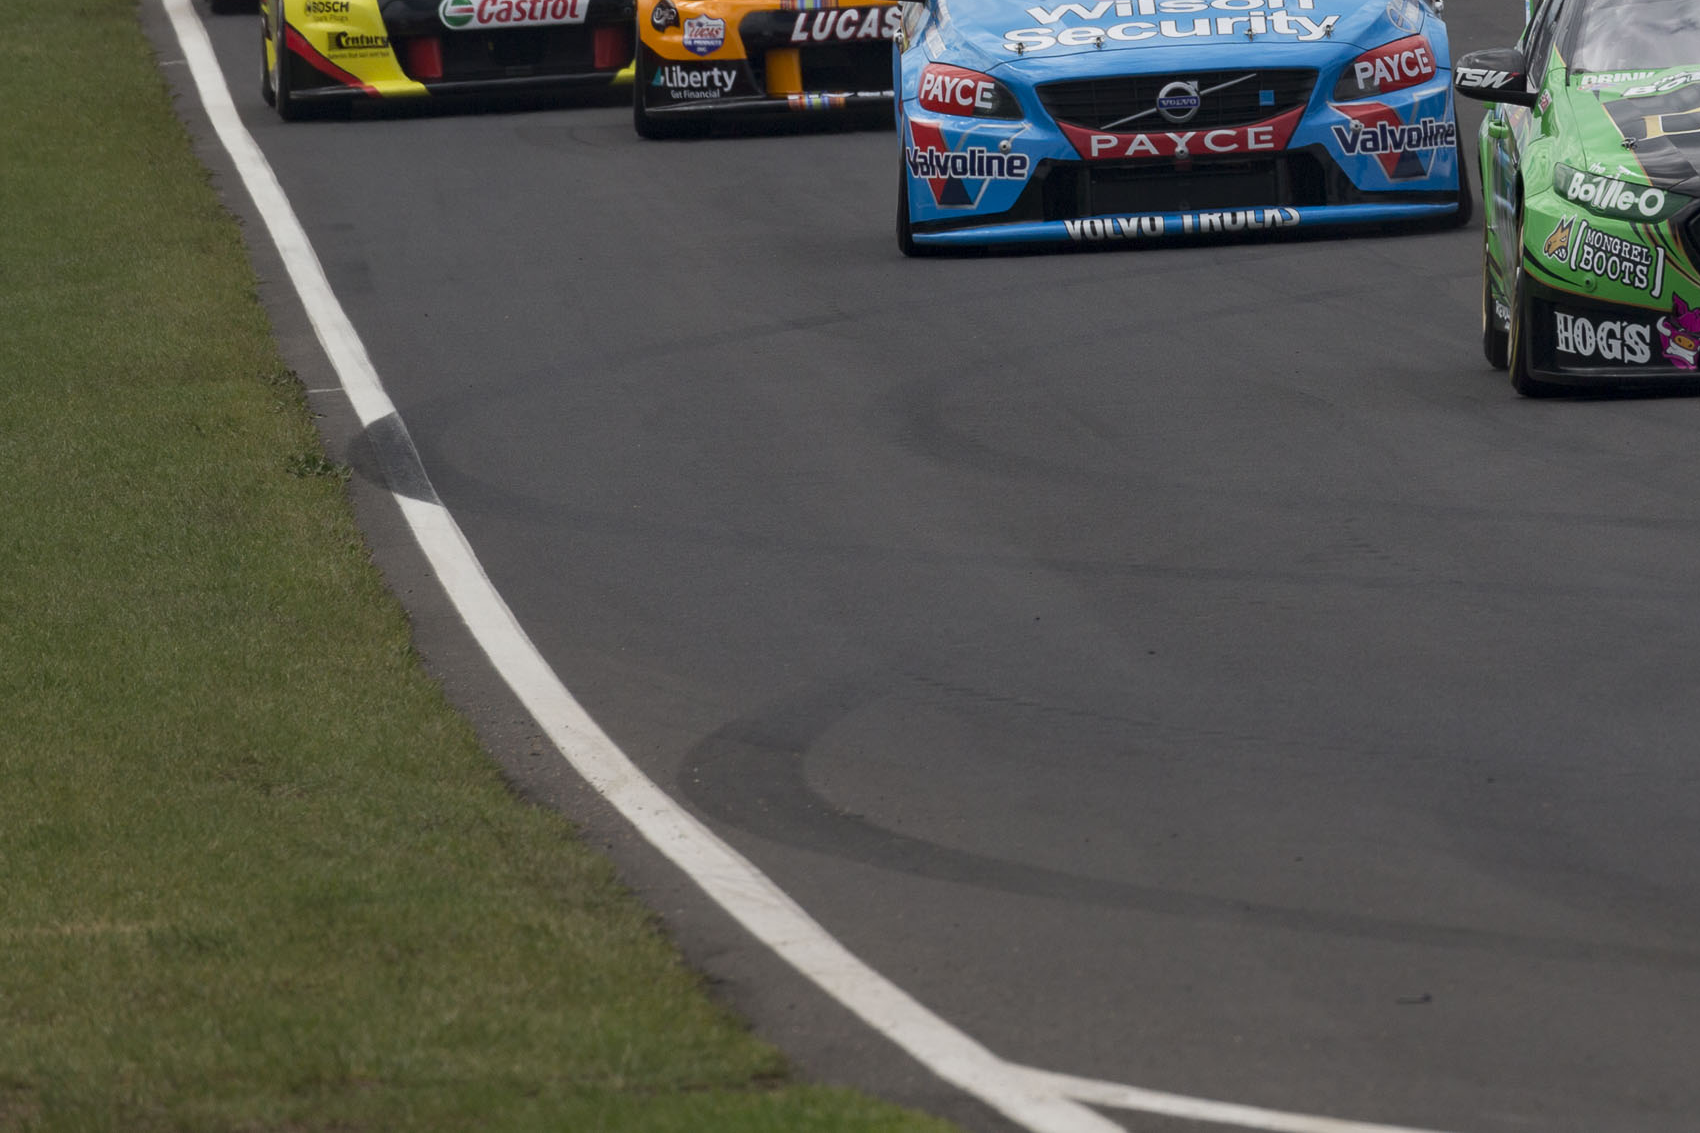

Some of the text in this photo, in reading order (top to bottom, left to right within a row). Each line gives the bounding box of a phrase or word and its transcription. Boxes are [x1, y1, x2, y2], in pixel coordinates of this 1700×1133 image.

[312, 1, 350, 14] BOSCH
[336, 30, 389, 49] Century
[789, 8, 903, 43] LUCAS
[1003, 9, 1341, 52] security
[664, 66, 737, 92] Liberty
[1354, 47, 1432, 91] PAYCE
[1454, 67, 1514, 89] TSW
[920, 73, 996, 110] PAYCE
[1161, 98, 1197, 107] VOLVO
[1090, 126, 1275, 158] PAYCE
[1331, 117, 1456, 156] Valvoline
[906, 145, 1030, 180] Valvoline
[1588, 162, 1606, 174] the
[1567, 165, 1666, 216] Bottle-O
[1064, 214, 1165, 242] VOLVO
[1585, 228, 1652, 264] MONGREL
[1579, 246, 1649, 290] BOOTS
